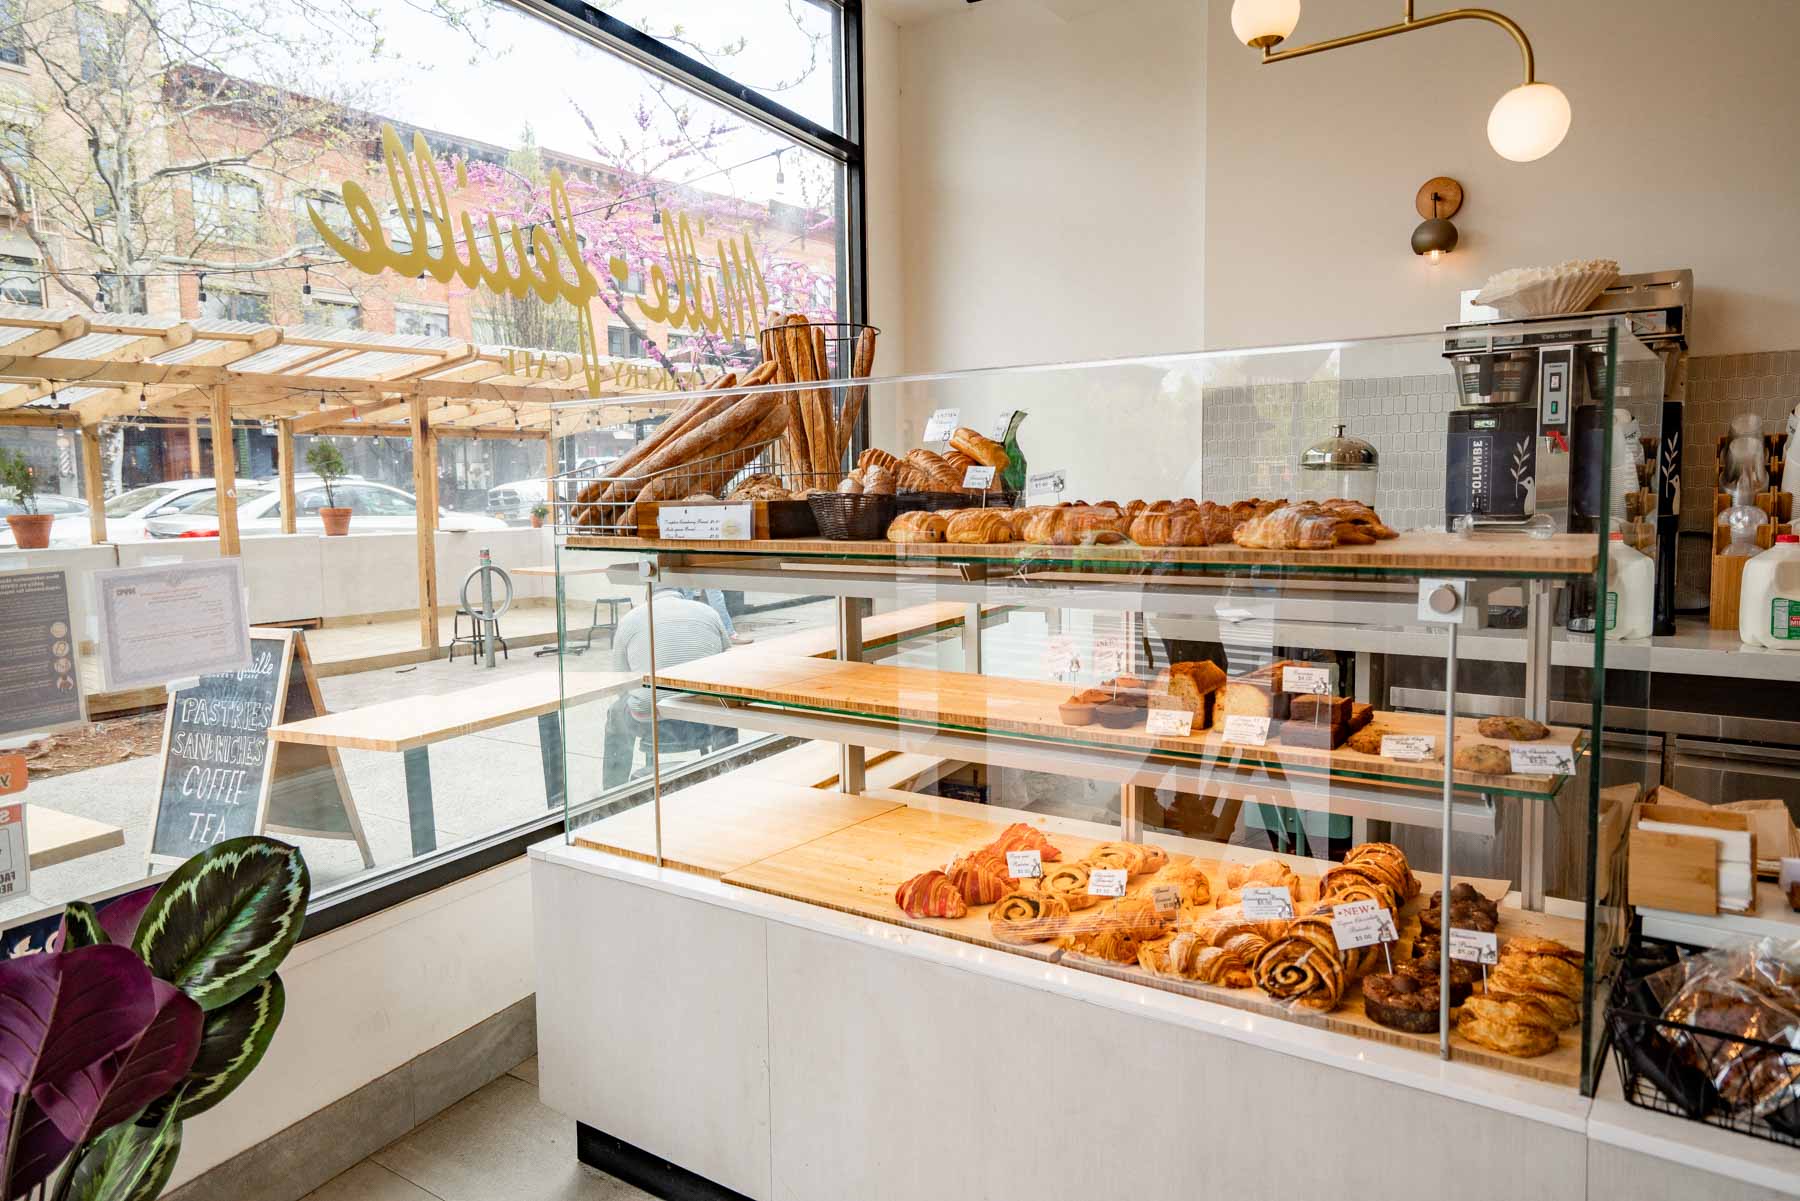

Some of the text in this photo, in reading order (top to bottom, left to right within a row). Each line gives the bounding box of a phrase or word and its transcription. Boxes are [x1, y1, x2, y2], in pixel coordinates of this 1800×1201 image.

[1472, 440, 1483, 494] COLOMBE
[181, 697, 274, 732] PASTRIES
[171, 730, 266, 767] SANDWICHES
[182, 765, 248, 805] COFFEE
[189, 812, 226, 845] TEA
[1343, 905, 1369, 917] NEW
